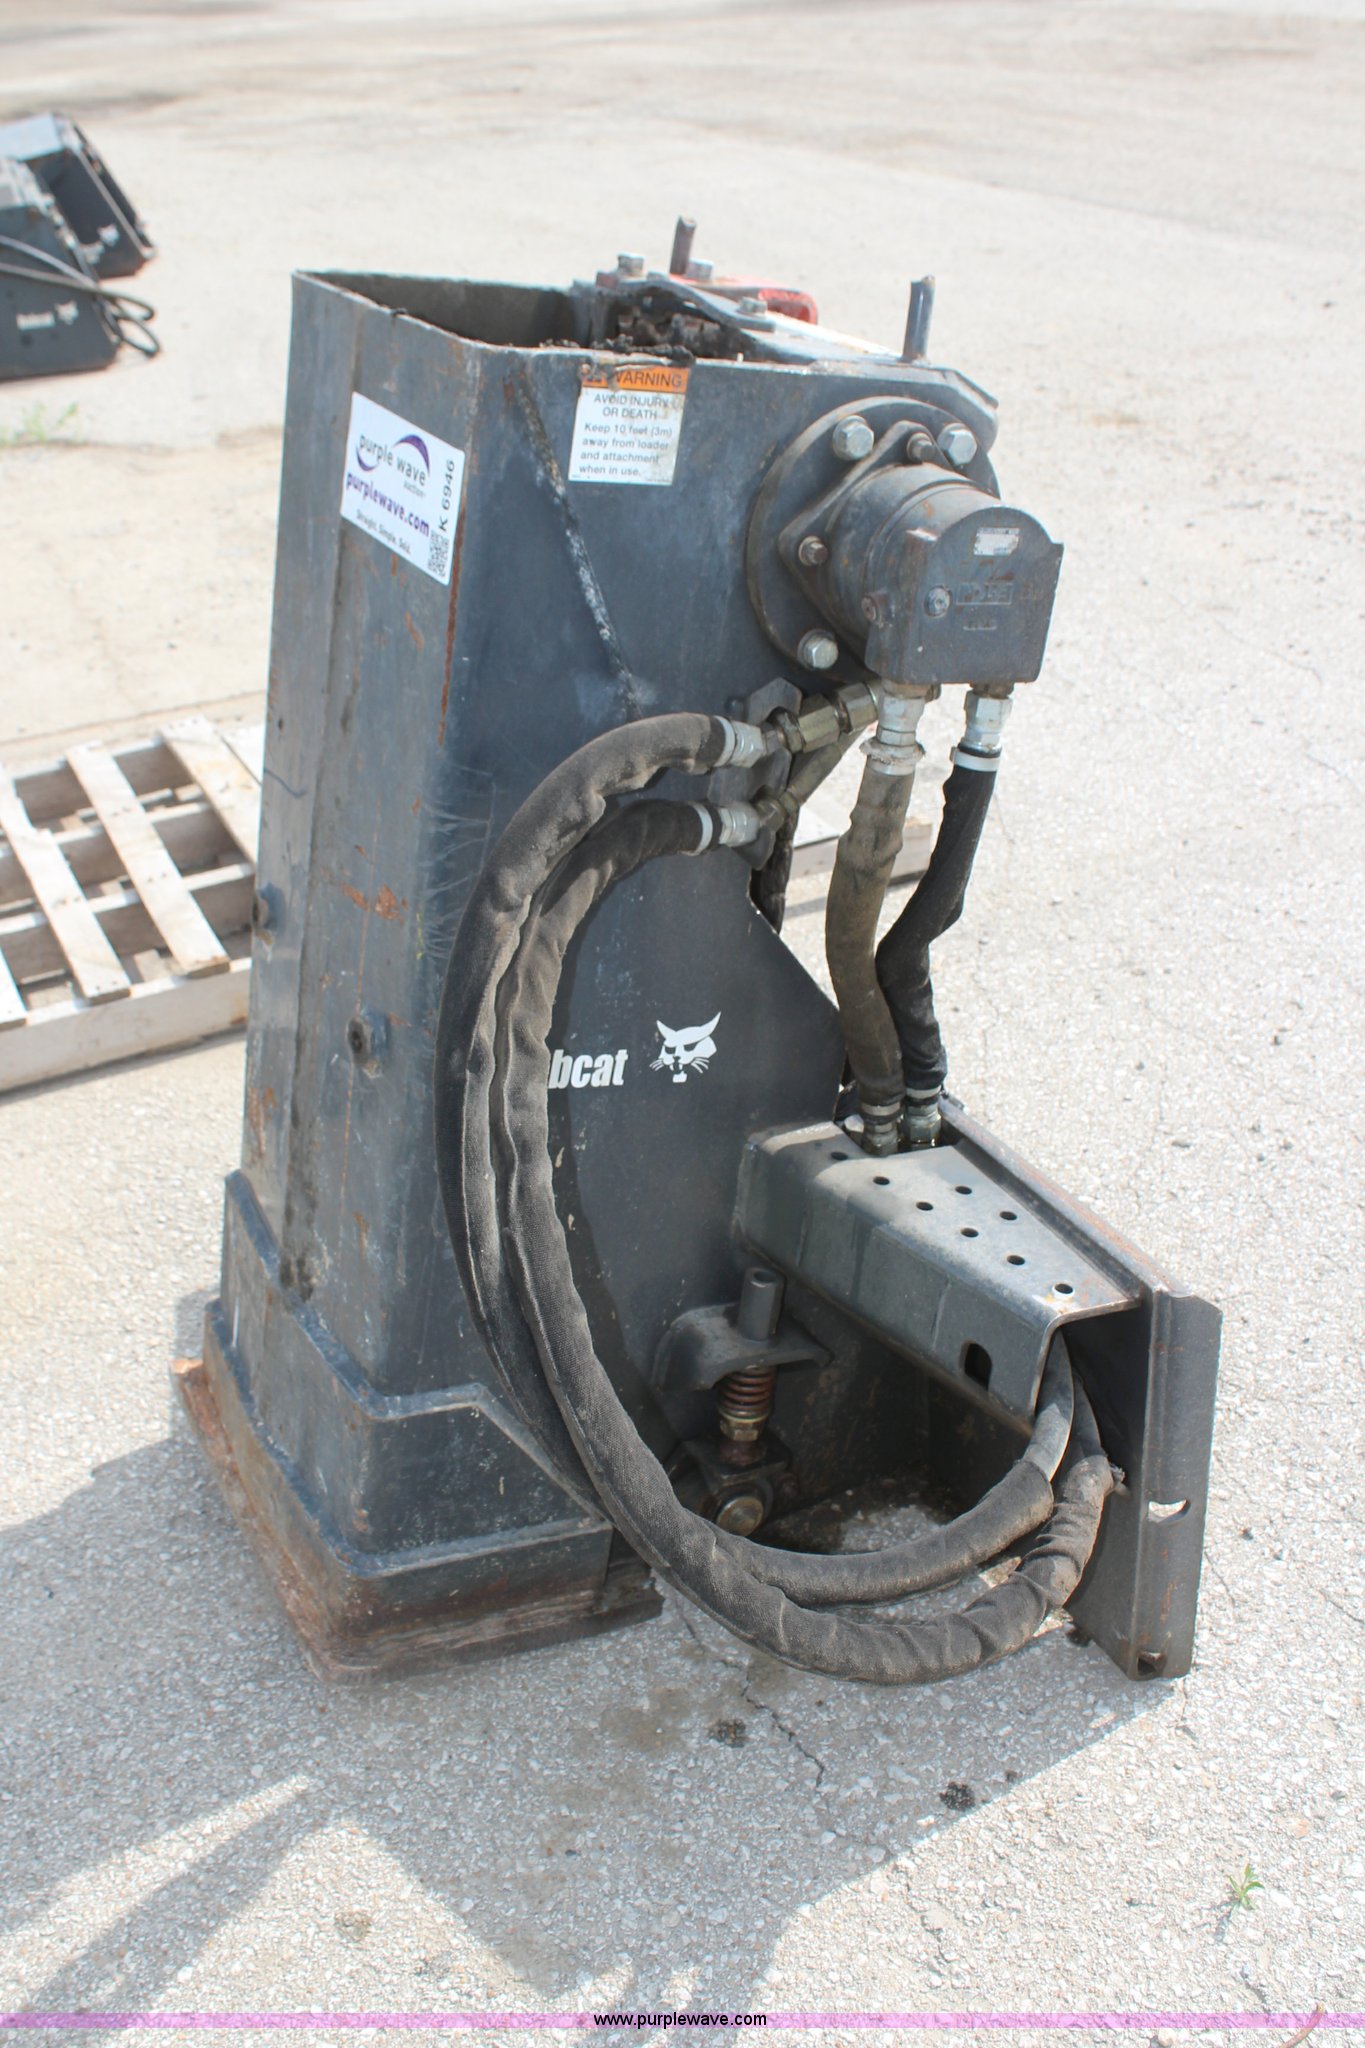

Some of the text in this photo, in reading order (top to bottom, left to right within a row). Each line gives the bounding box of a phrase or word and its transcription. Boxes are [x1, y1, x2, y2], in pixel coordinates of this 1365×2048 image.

[594, 393, 669, 408] AVOID INJURY
[602, 406, 658, 420] OR DEATH
[584, 422, 672, 438] Keep 10 feet (3m)
[582, 437, 669, 450] away from loader
[359, 434, 427, 487] purple wave
[580, 450, 660, 464] and attachment
[579, 464, 641, 477] when in use.
[439, 459, 455, 533] K 6946
[346, 473, 430, 537] purplewave.com
